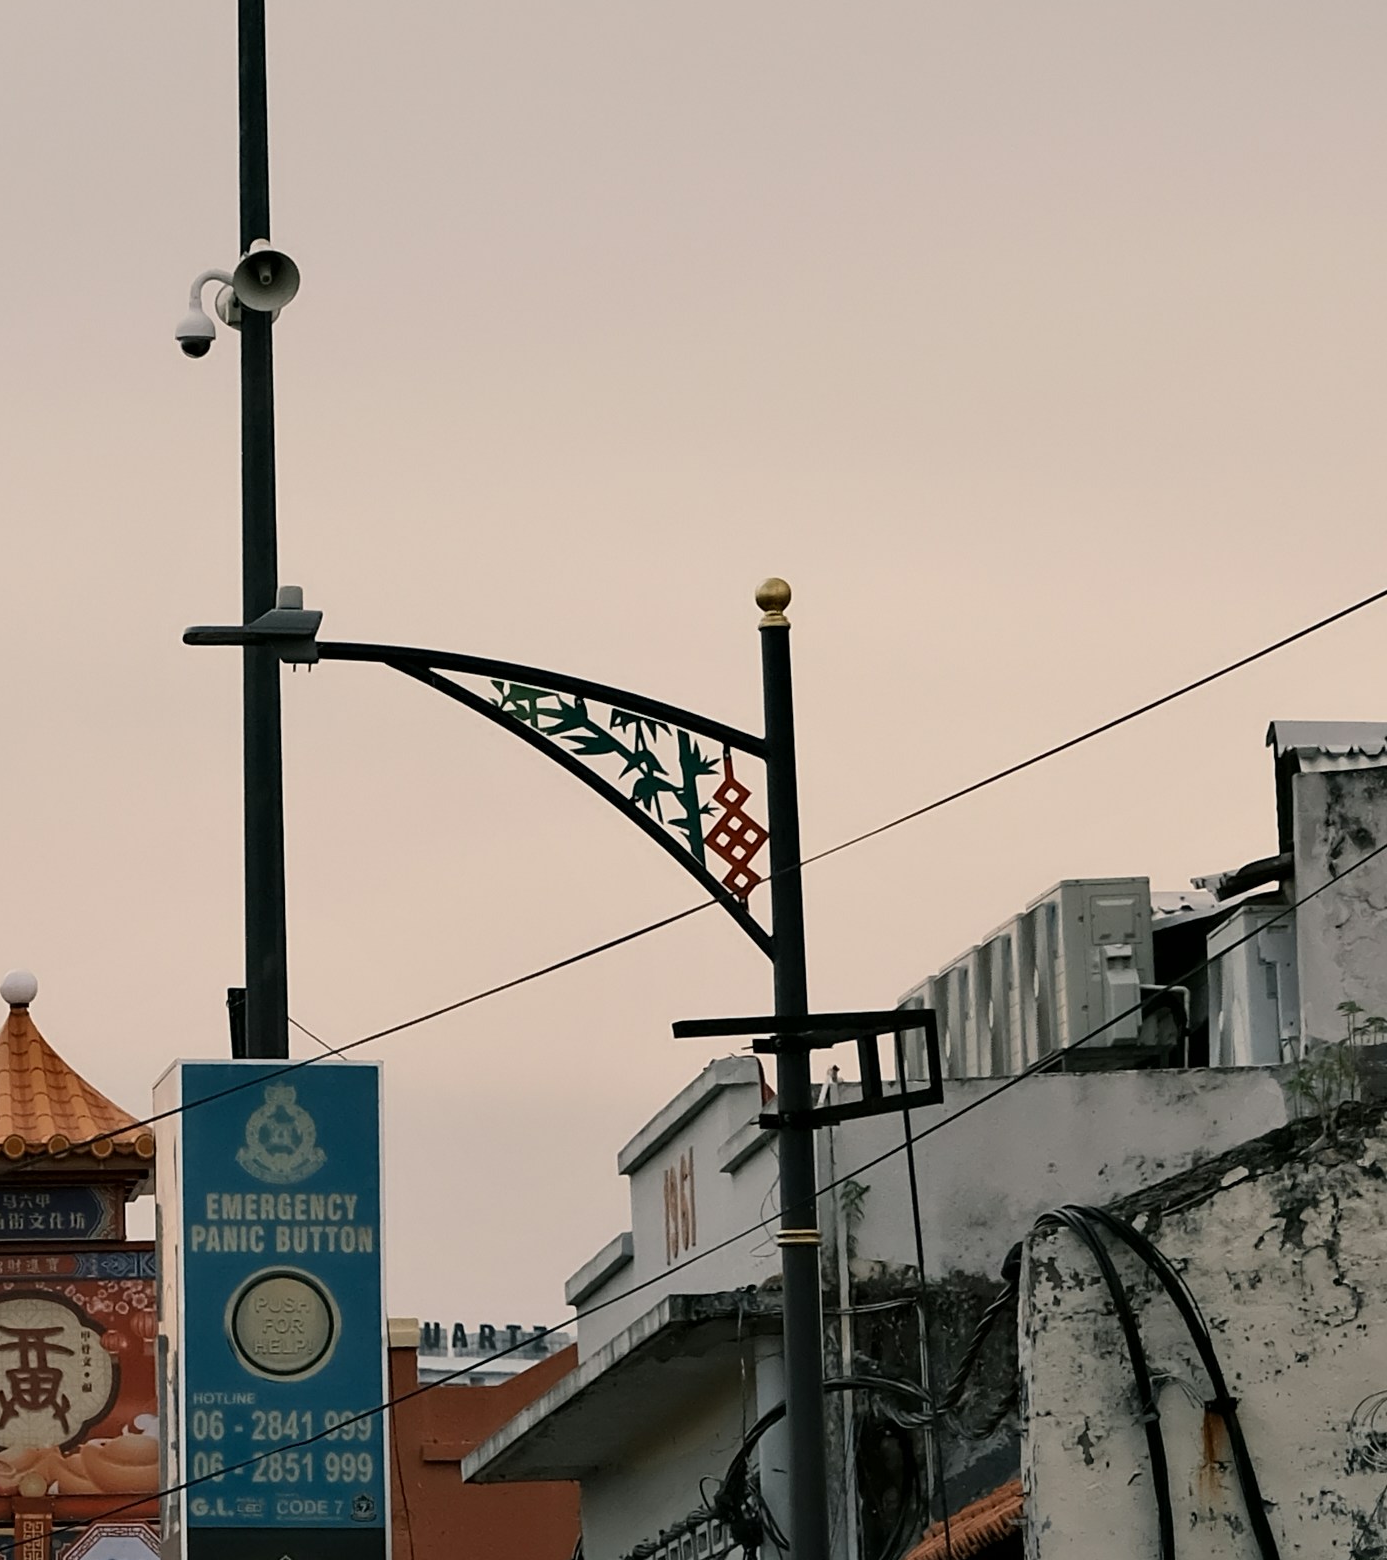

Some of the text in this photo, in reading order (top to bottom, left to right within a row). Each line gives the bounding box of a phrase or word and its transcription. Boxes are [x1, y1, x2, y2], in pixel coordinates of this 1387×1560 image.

[206, 1192, 358, 1221] EMERGENCY
[191, 1225, 373, 1254] PANIC BUTTON
[256, 1297, 310, 1314] PUSH
[262, 1319, 305, 1335] FOR
[192, 1393, 256, 1405] HOTLINE
[192, 1409, 225, 1441] 06
[251, 1409, 313, 1441] 2841
[324, 1409, 373, 1442] 999
[192, 1451, 225, 1483] 06
[251, 1451, 314, 1483] 2851
[324, 1451, 374, 1484] 999
[276, 1499, 328, 1515] CODE
[334, 1499, 344, 1515] 7
